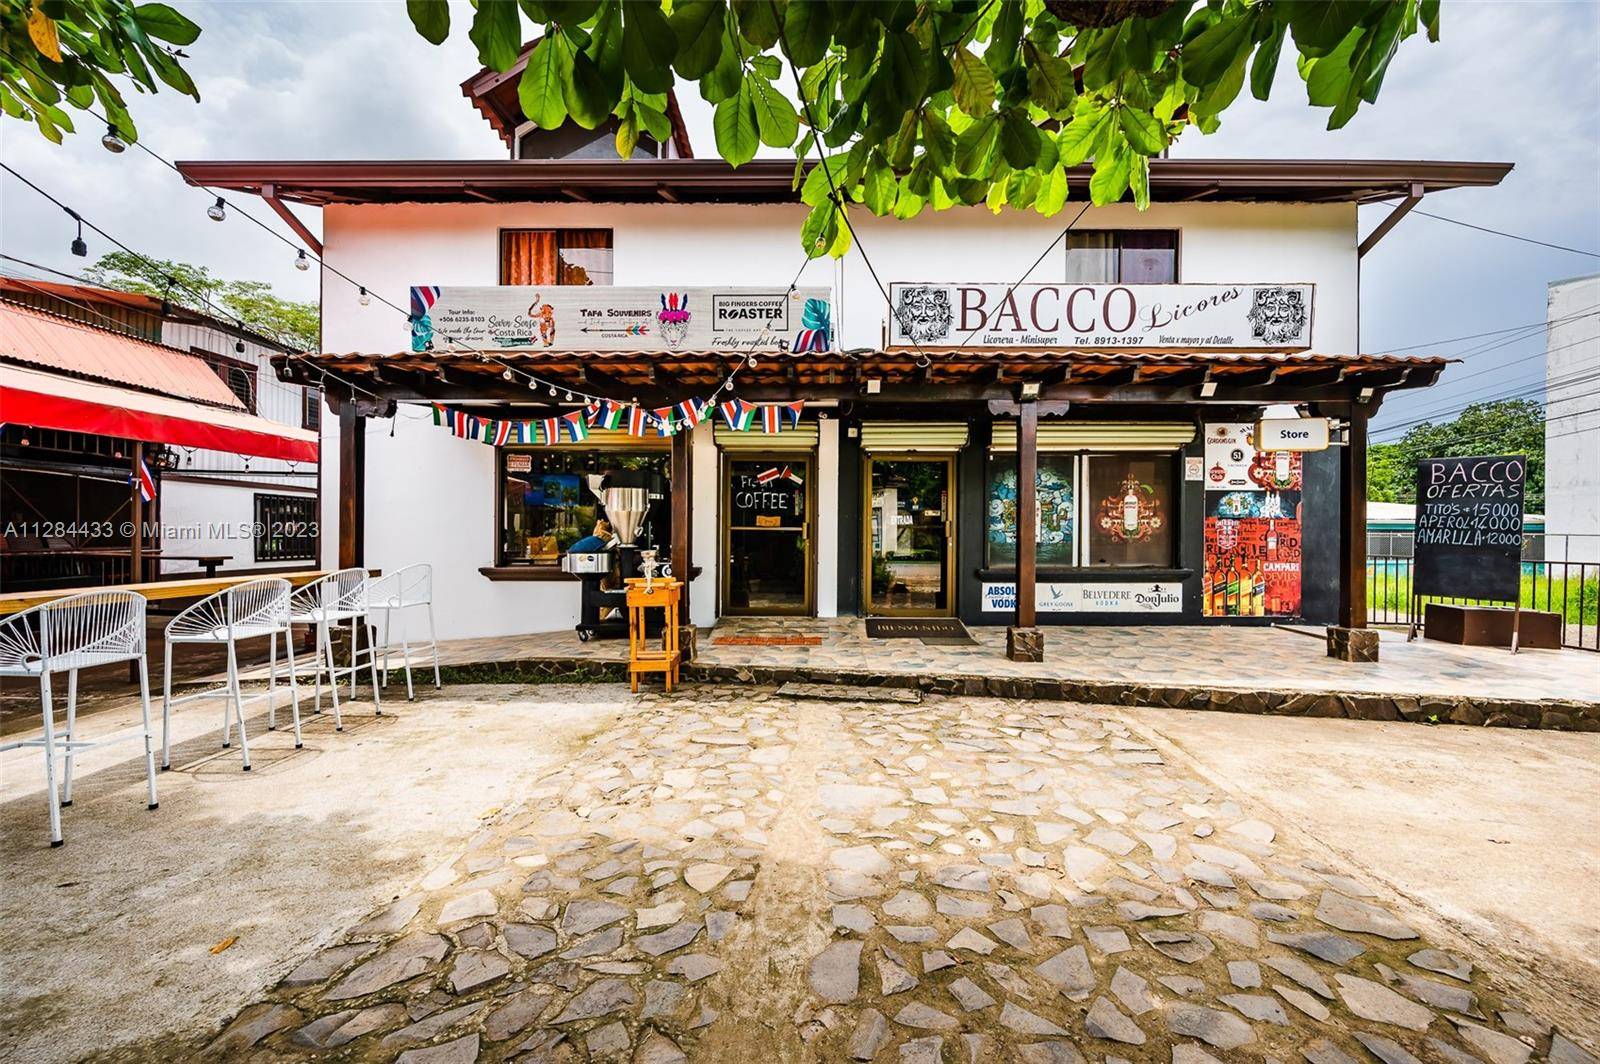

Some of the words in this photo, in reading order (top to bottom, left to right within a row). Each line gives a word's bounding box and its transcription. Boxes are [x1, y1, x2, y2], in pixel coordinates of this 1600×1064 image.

[718, 308, 783, 319] ROASTER
[955, 286, 1137, 333] BACCO
[1138, 287, 1244, 333] Licores
[494, 329, 515, 337] Costa
[516, 329, 533, 337] Rica
[711, 336, 740, 348] Freshly
[741, 336, 769, 346] roasted
[983, 335, 1014, 344] Licorera
[1020, 335, 1059, 345] Minisuper
[1074, 336, 1092, 345] Tel.
[1093, 336, 1145, 345] 8913-1397
[1159, 335, 1175, 344] Venta
[1180, 338, 1200, 346] mayor
[1205, 335, 1213, 344] al
[1213, 335, 1234, 345] Detalle
[1280, 430, 1309, 439] Store
[1431, 460, 1524, 485] BACCO
[1426, 483, 1521, 499] OFERTAS
[735, 492, 788, 509] COFFEE
[1424, 503, 1461, 516] TITO'S
[1472, 503, 1520, 517] 15000
[1418, 514, 1470, 529] APEROL
[1417, 528, 1481, 545] AMARULA
[1486, 532, 1521, 546] 12000
[1263, 562, 1300, 572] CAMPARI
[987, 586, 1017, 596] ABSOL
[1082, 589, 1132, 600] BELVEDERE
[991, 599, 1017, 609] VODK
